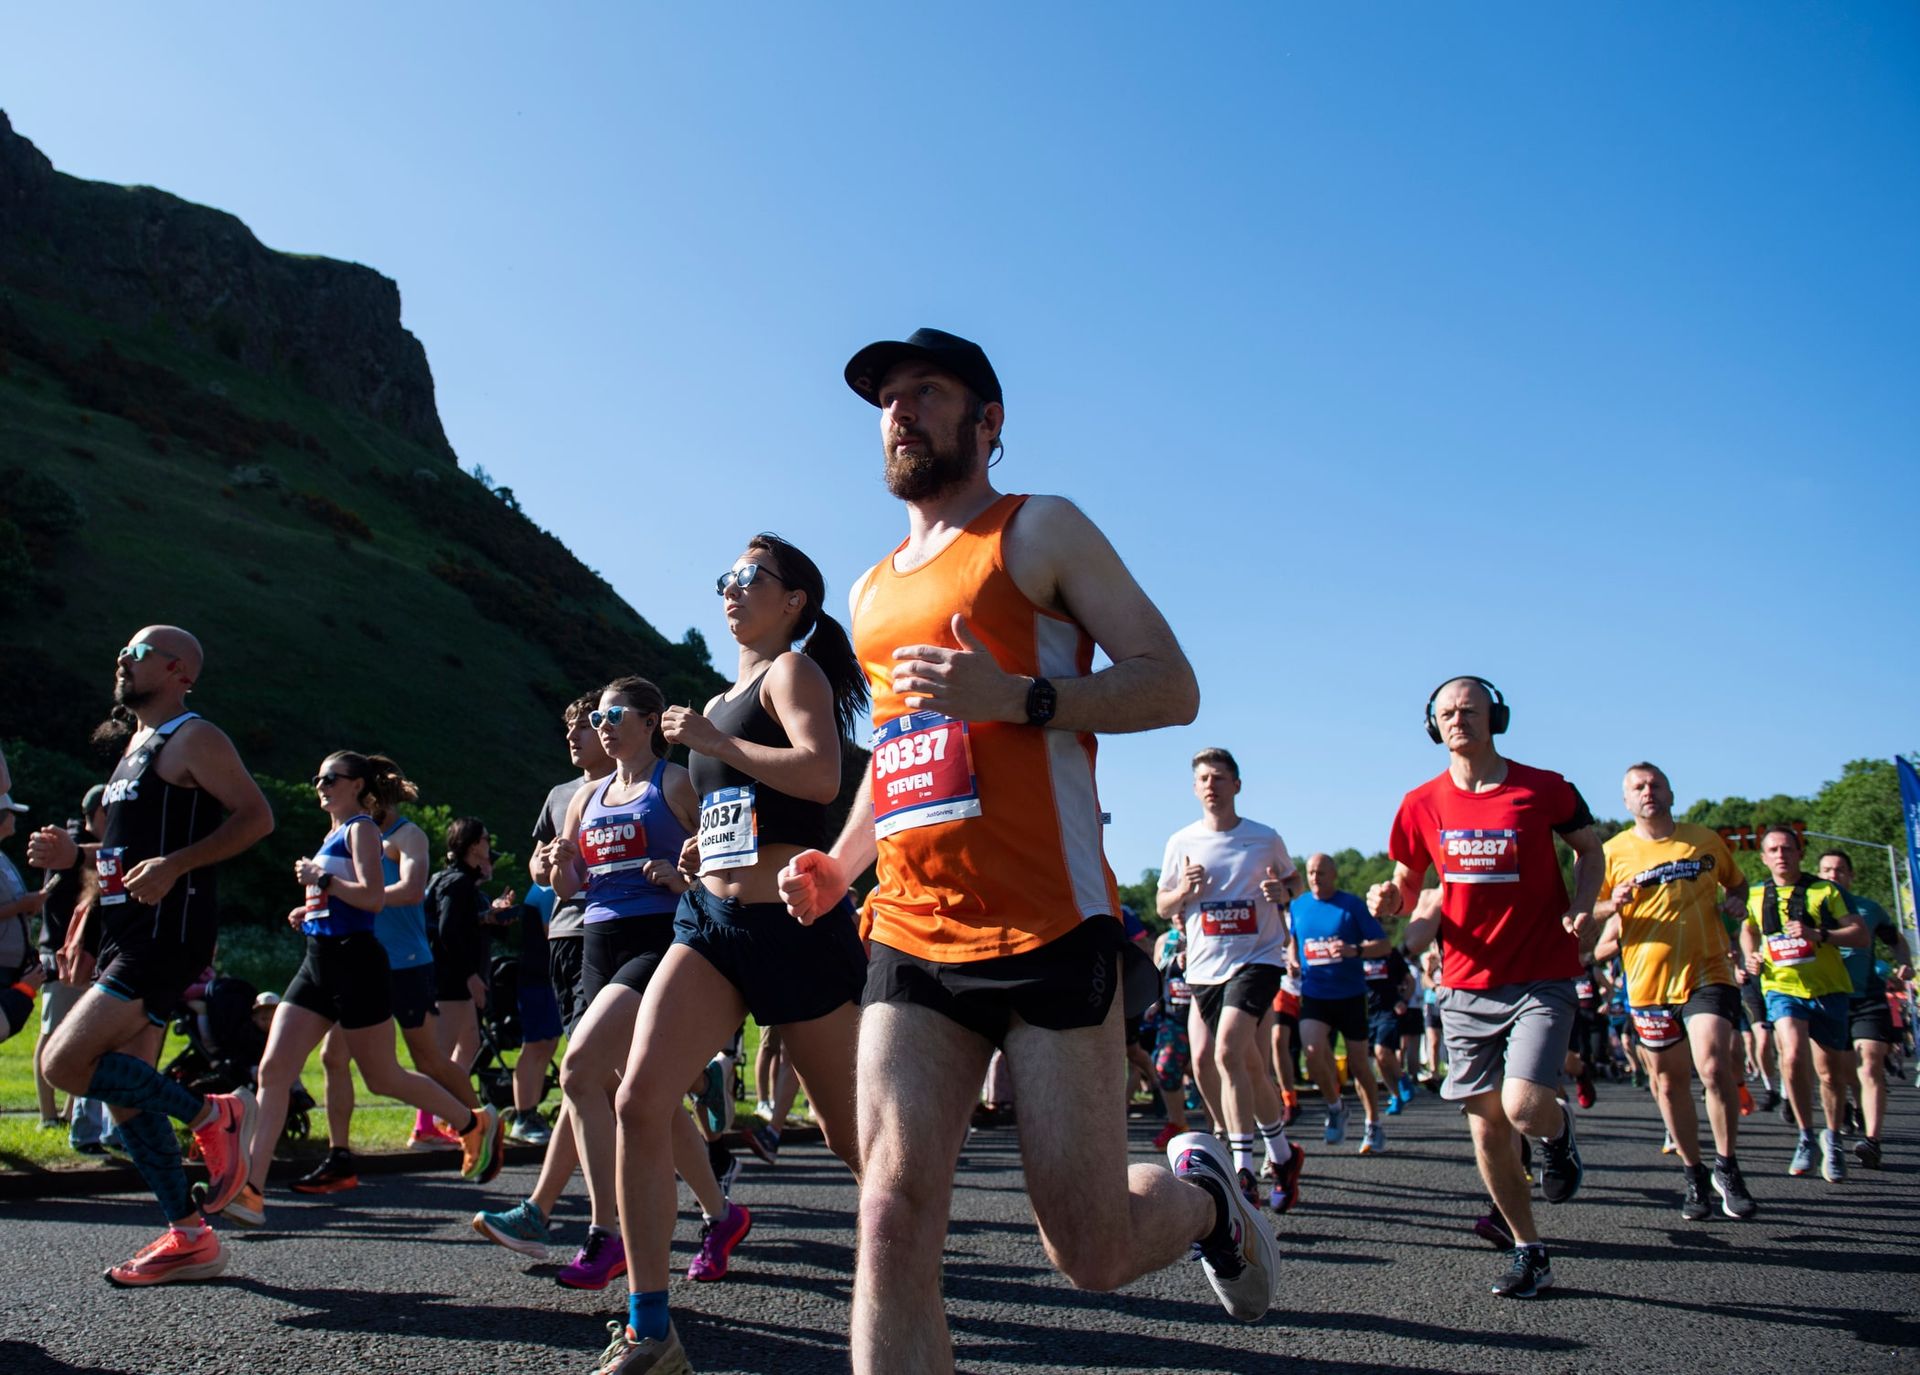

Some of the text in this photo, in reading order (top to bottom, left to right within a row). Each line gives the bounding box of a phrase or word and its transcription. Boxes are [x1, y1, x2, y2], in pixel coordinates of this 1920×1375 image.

[875, 728, 949, 780] 50337
[886, 771, 934, 798] STEVEN
[701, 802, 742, 836] 0037
[585, 823, 636, 848] 50370
[596, 843, 626, 857] SOPHIE
[1447, 839, 1508, 857] 50287
[1459, 857, 1496, 868] MARTIN
[1206, 907, 1250, 923] 50278
